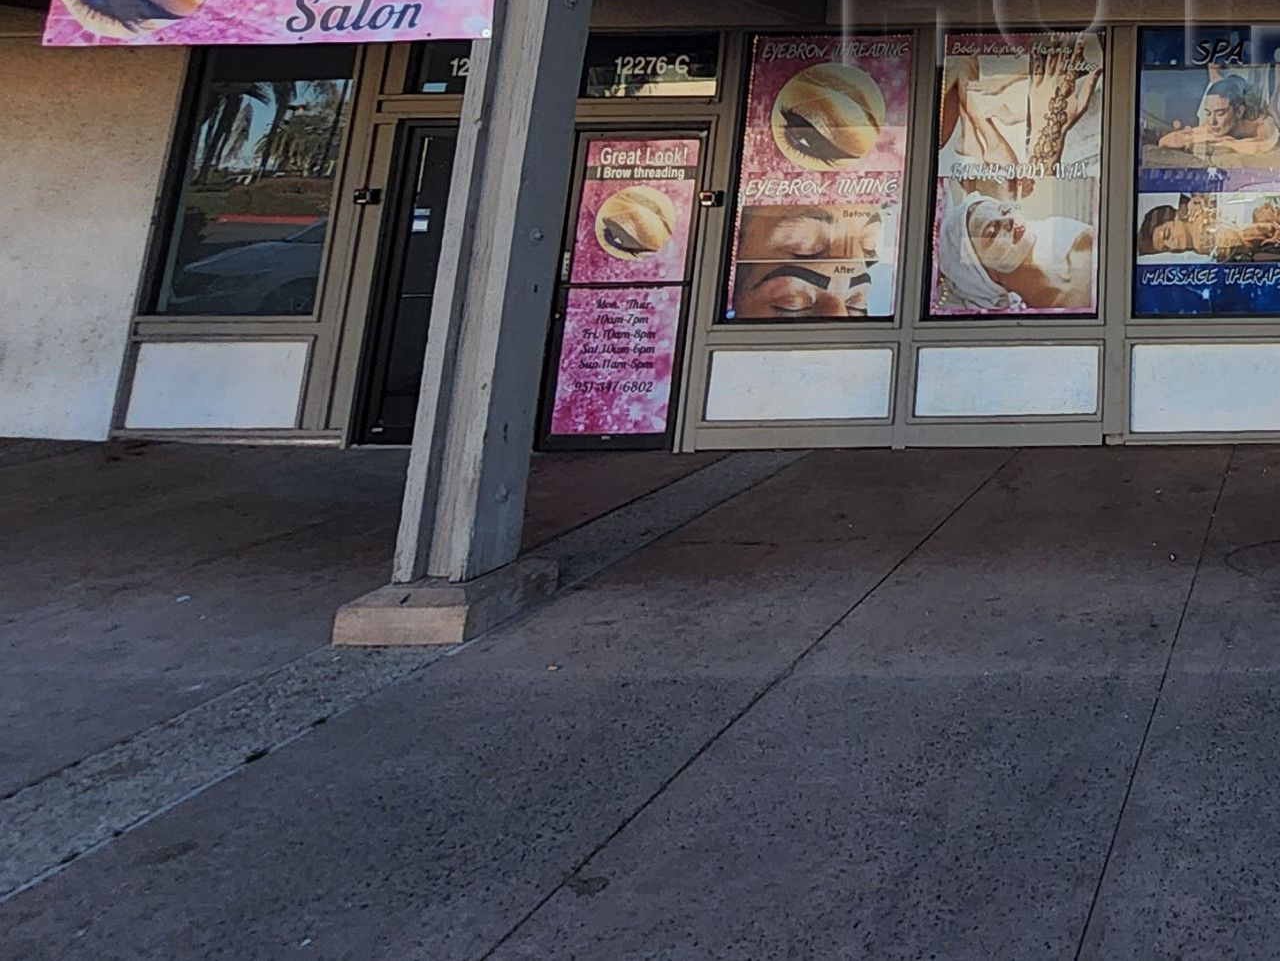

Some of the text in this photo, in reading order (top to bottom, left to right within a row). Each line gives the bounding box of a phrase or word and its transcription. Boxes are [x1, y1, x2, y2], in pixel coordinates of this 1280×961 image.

[762, 42, 829, 62] EYEBROW
[952, 42, 980, 56] Body
[1191, 40, 1246, 65] SPA
[600, 146, 688, 166] Great Look!
[603, 166, 632, 178] Brow
[634, 167, 685, 180] threading
[1006, 163, 1048, 179] BODY
[746, 178, 899, 199] EYEBROW TINTING
[834, 266, 855, 274] After
[1142, 268, 1218, 285] MASSAGE
